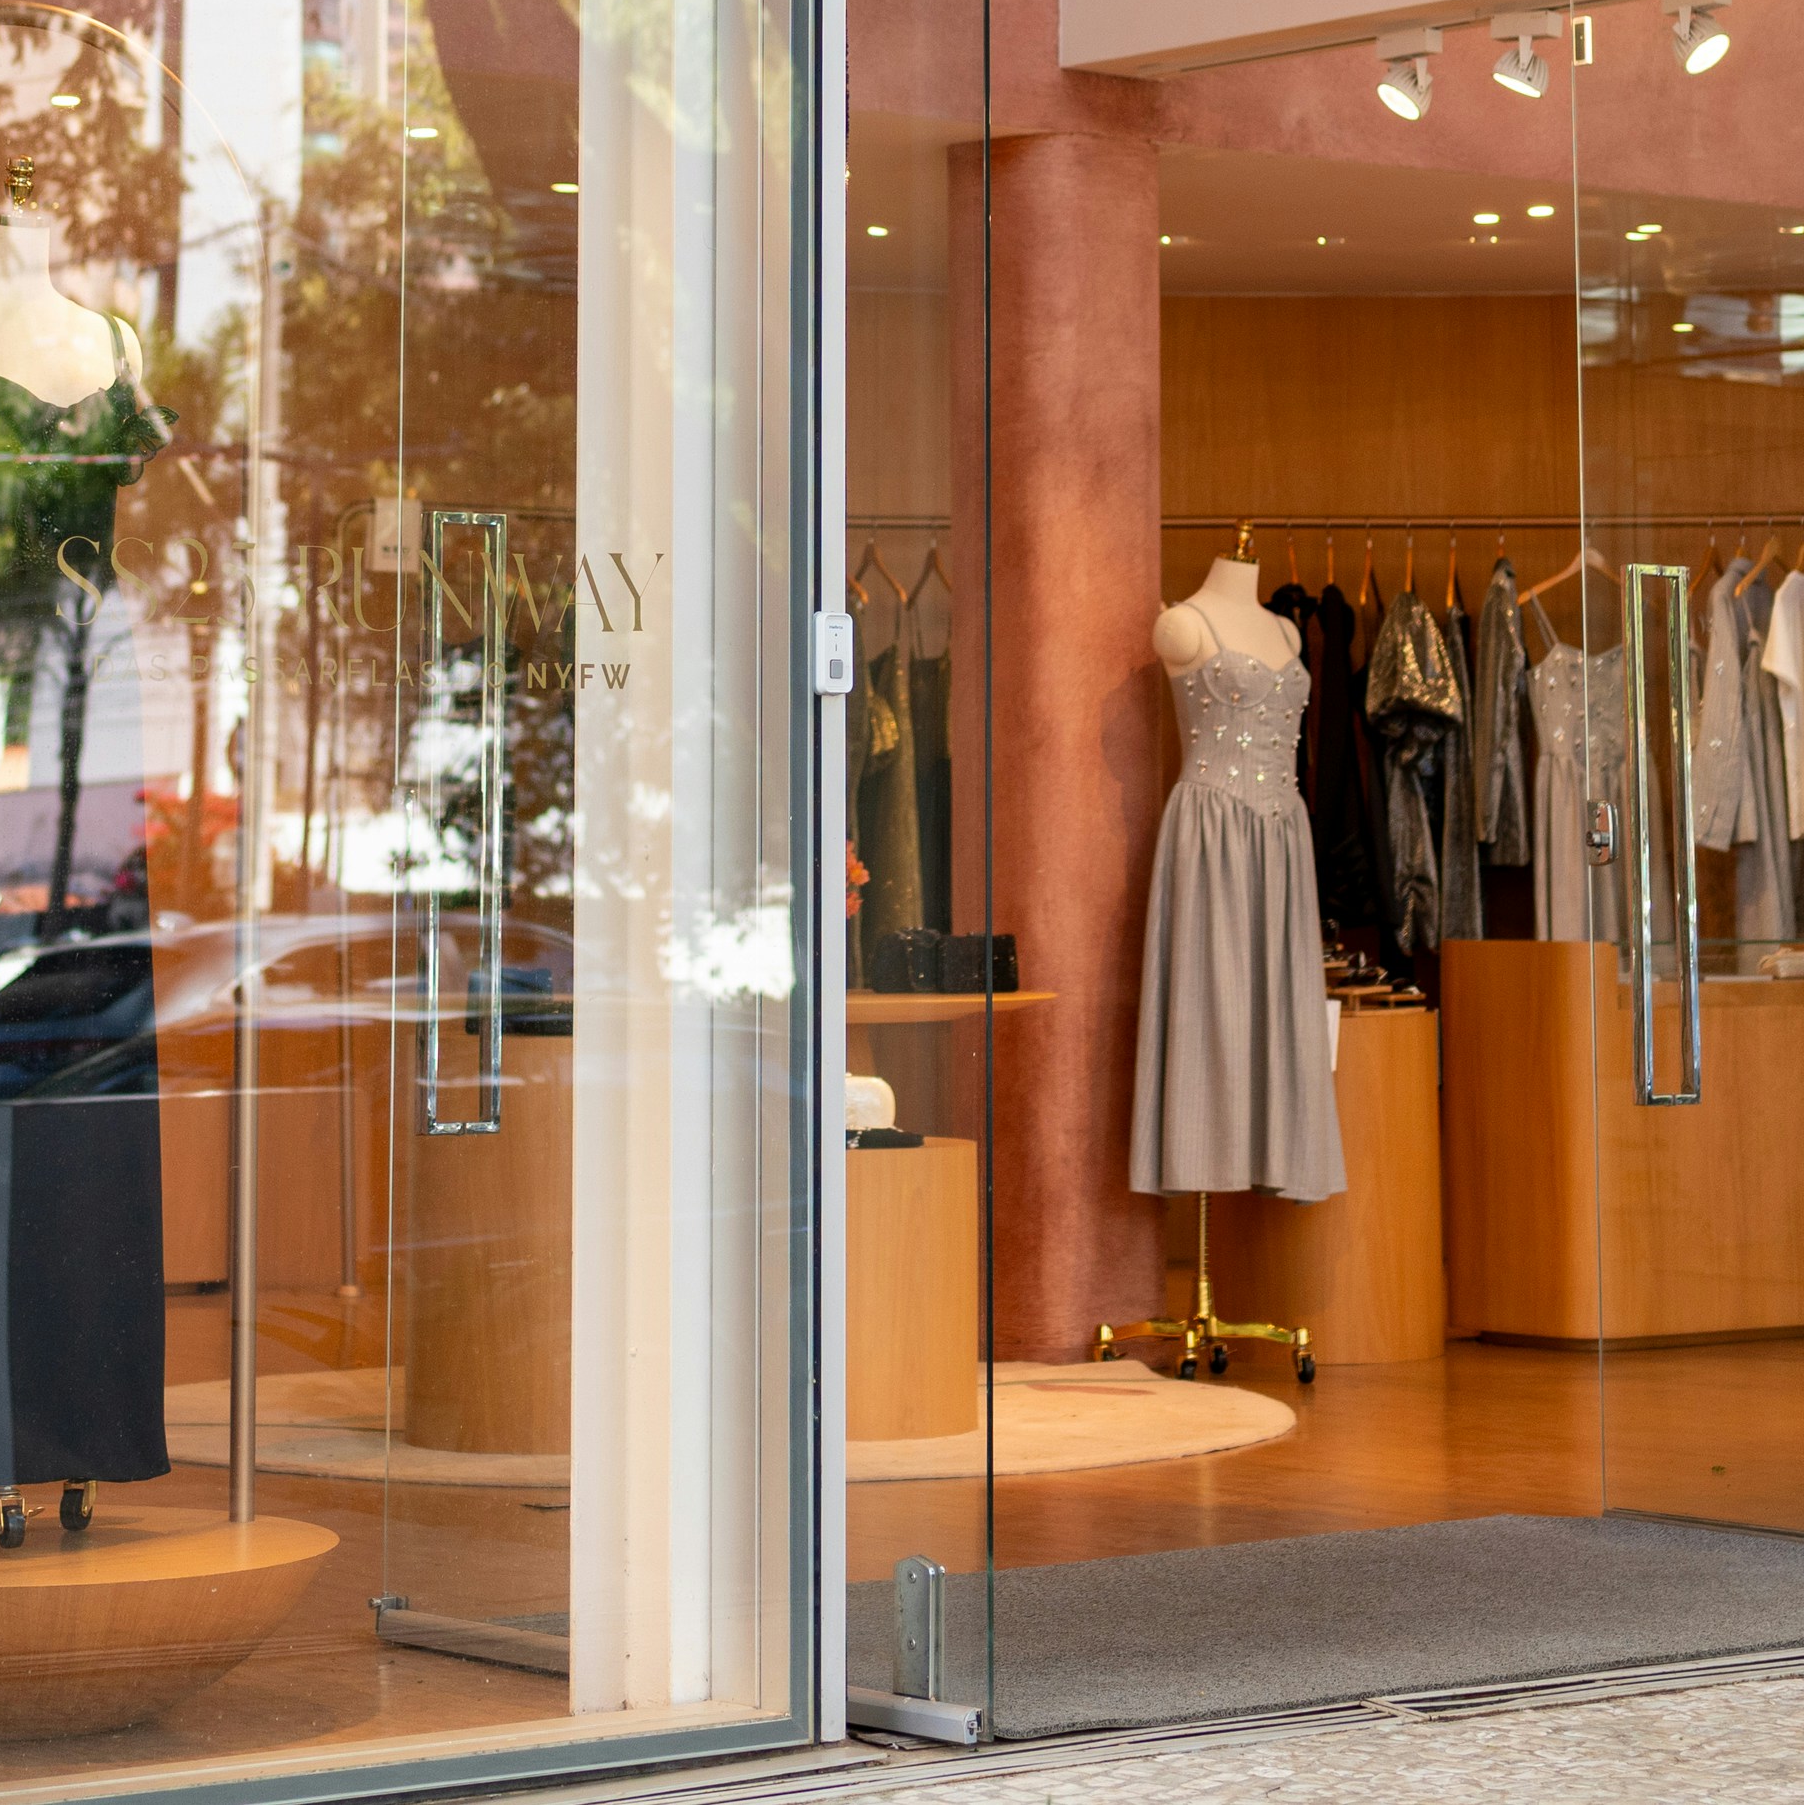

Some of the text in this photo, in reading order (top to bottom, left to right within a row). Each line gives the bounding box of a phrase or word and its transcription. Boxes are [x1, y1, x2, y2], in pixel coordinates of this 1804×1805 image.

[55, 535, 665, 633] SS25 RUNWAY
[95, 654, 168, 683] DAS
[526, 662, 632, 690] NYFW
